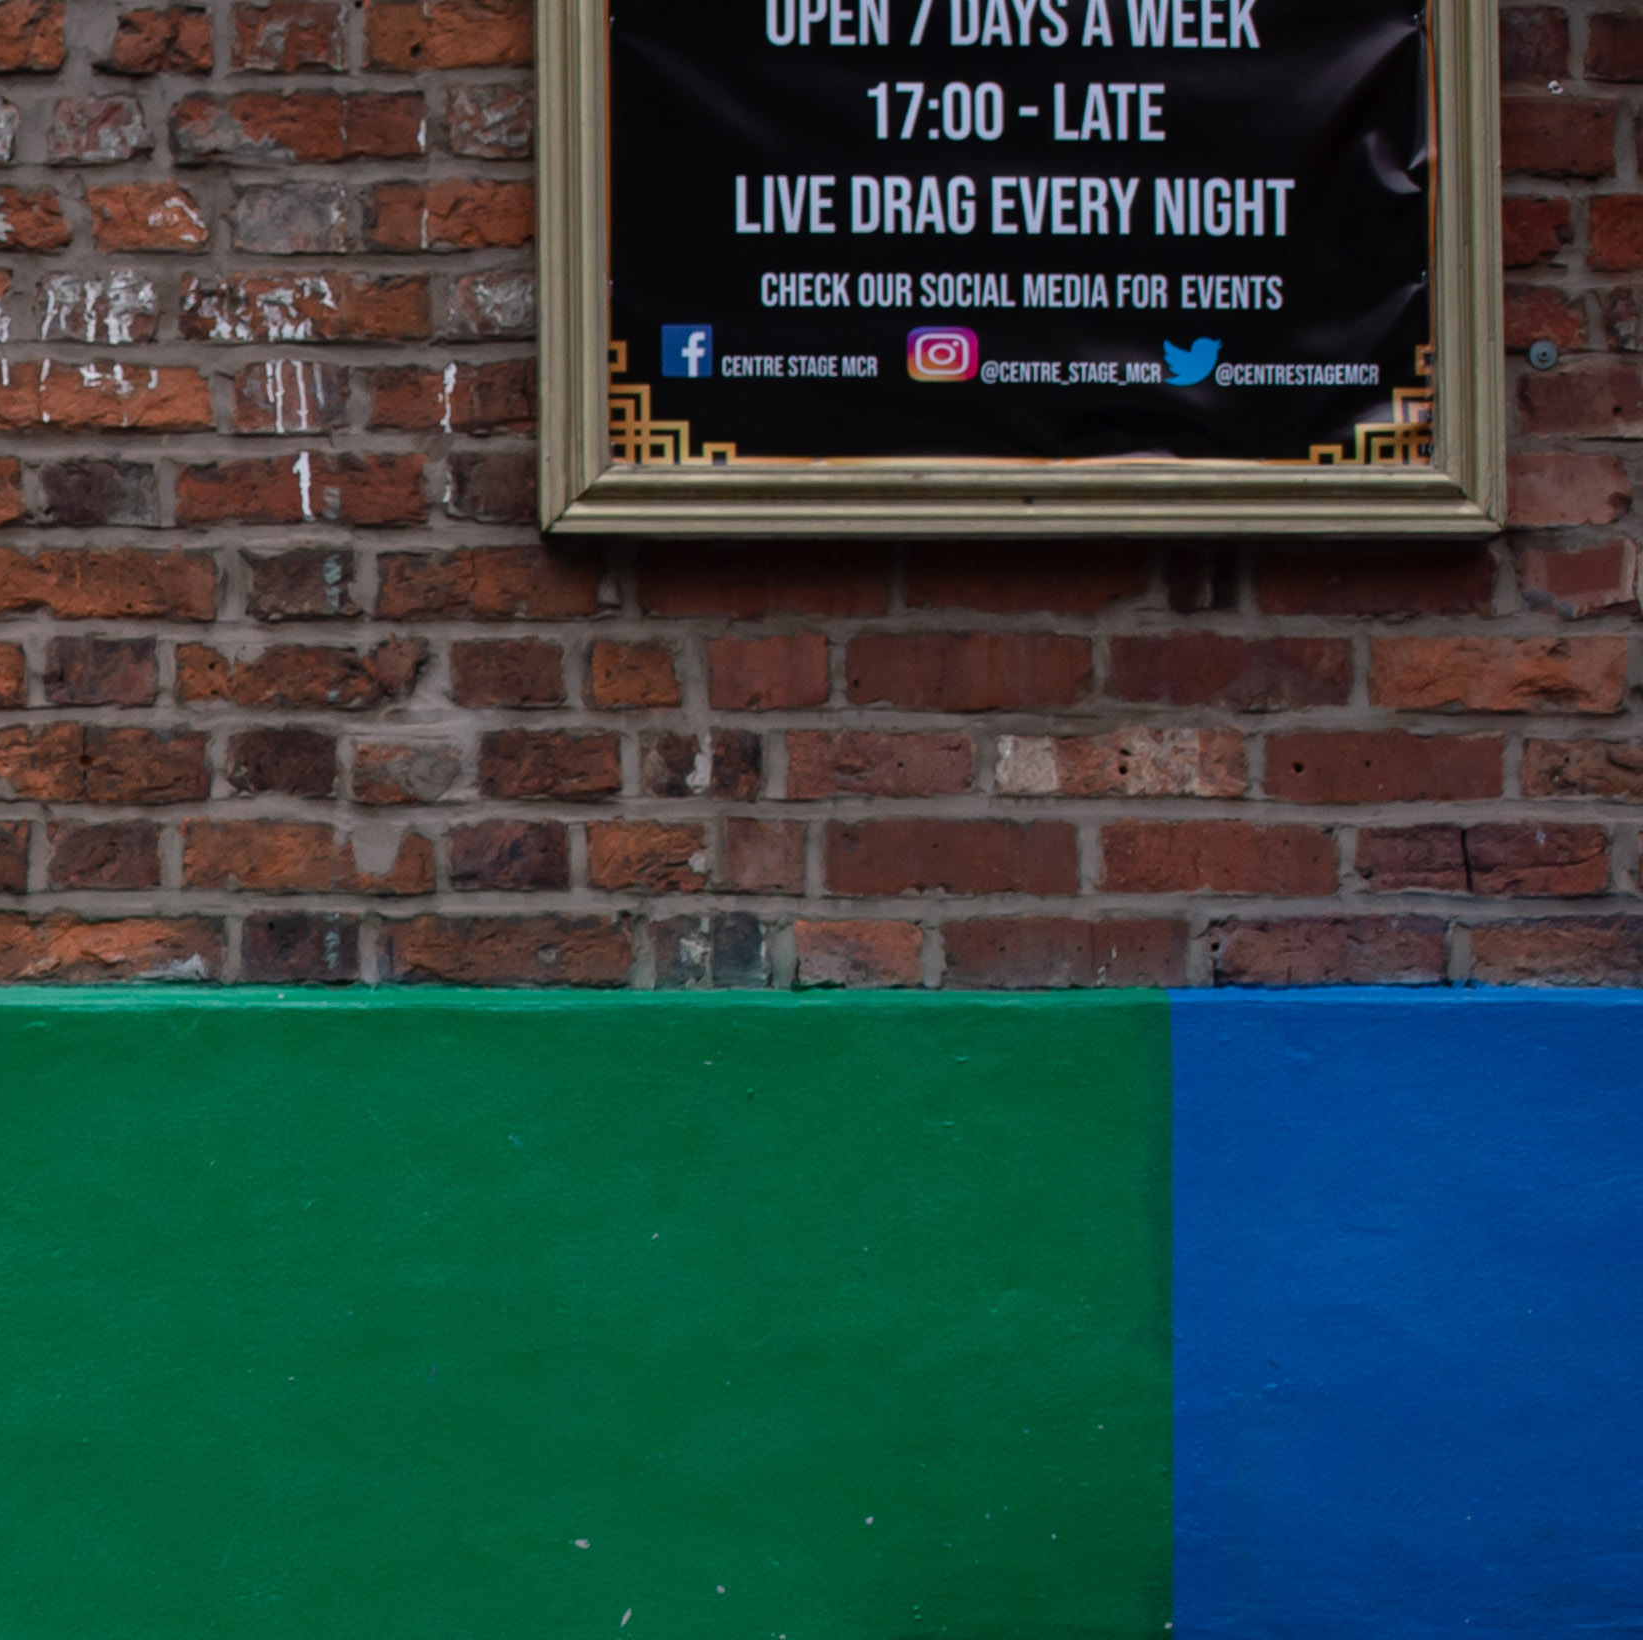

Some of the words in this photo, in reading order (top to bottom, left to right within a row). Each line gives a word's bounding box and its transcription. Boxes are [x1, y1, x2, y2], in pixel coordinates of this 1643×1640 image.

[765, 0, 889, 46] OPEN
[950, 0, 1069, 47] DAYS
[1081, 0, 1114, 47] A
[1126, 0, 1260, 49] WEEK
[866, 81, 1004, 141] 17:00
[1053, 82, 1166, 141] LATE
[735, 175, 836, 234] LIVE
[850, 175, 976, 235] DRAG
[991, 176, 1140, 235] EVERY
[1154, 177, 1295, 237] NIGHT
[761, 272, 851, 308] CHECK
[857, 272, 913, 308] OUR
[919, 272, 1016, 308] SOCIAL
[1023, 273, 1109, 308] MEDIA
[1116, 273, 1168, 309] FOR
[1181, 274, 1283, 310] EVENTS
[721, 355, 785, 377] CENTRE
[787, 355, 838, 378] STAGE
[841, 355, 878, 378] MCR
[980, 360, 1163, 386] @CENTRE_STAGE_MCR
[1214, 363, 1380, 387] @CENTRESTAGEMCR
